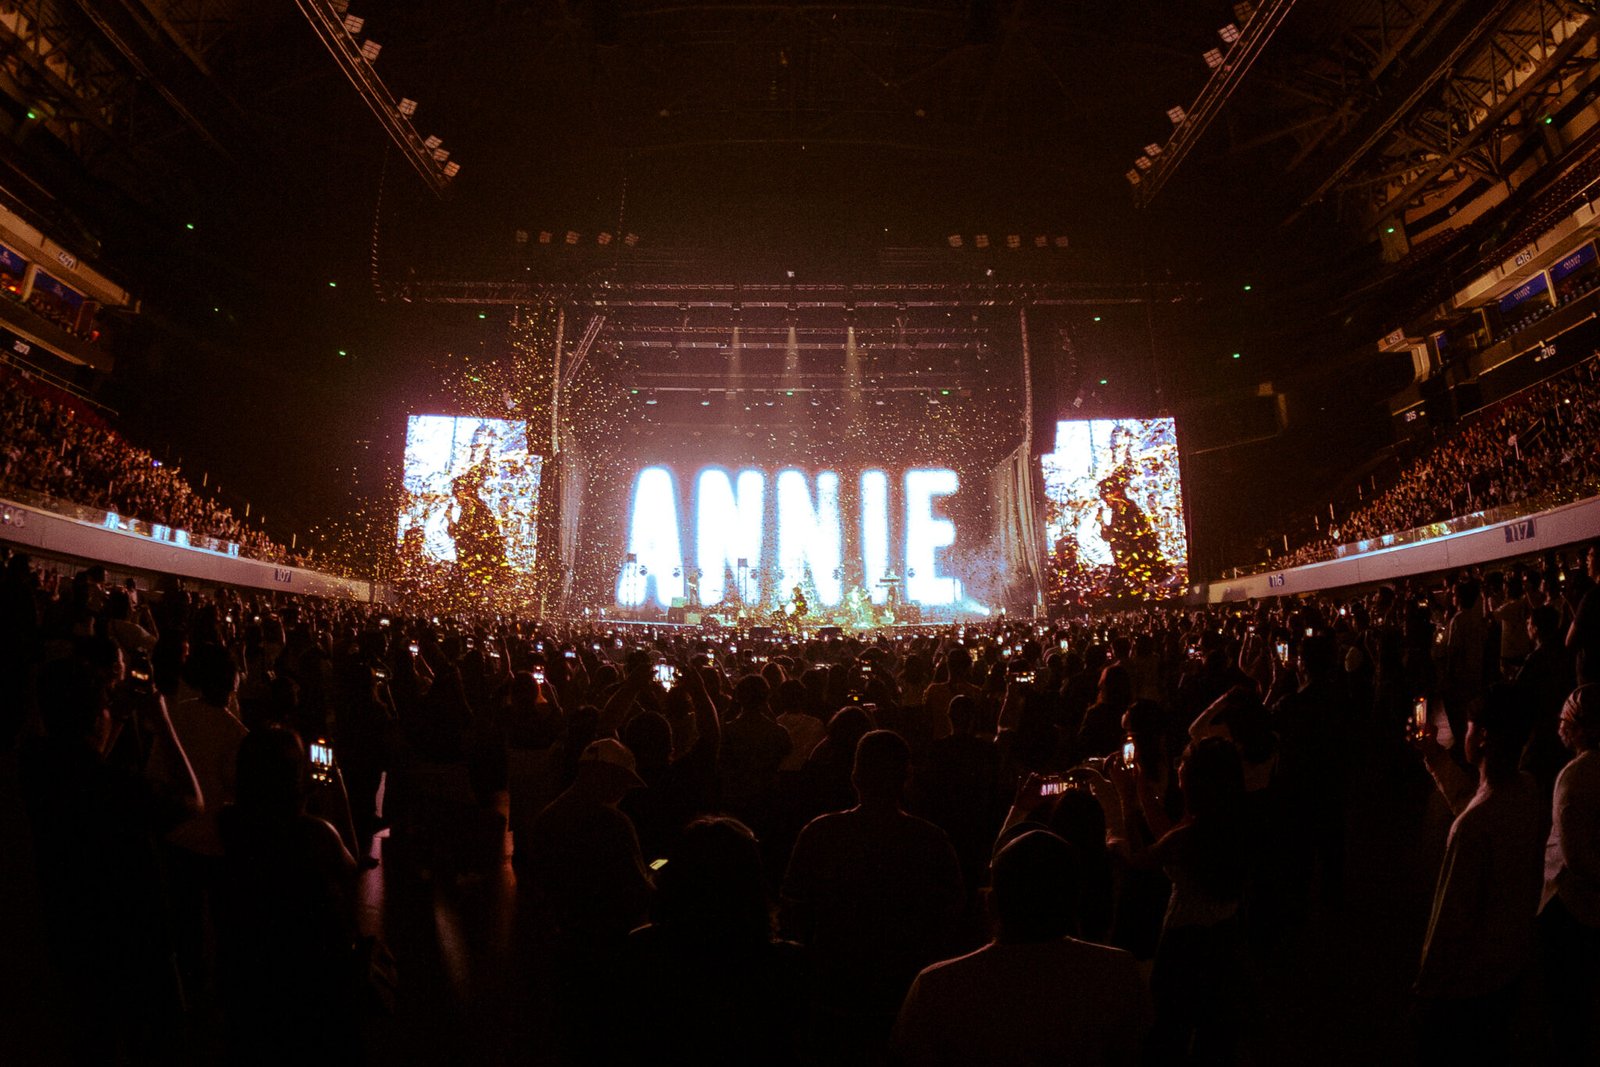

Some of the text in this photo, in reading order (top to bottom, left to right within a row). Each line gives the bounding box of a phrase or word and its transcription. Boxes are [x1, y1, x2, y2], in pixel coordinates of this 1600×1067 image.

[1541, 344, 1556, 359] 216
[616, 465, 964, 607] ANNIE
[1509, 521, 1529, 542] 117
[276, 568, 291, 582] 107
[1270, 574, 1284, 587] 116
